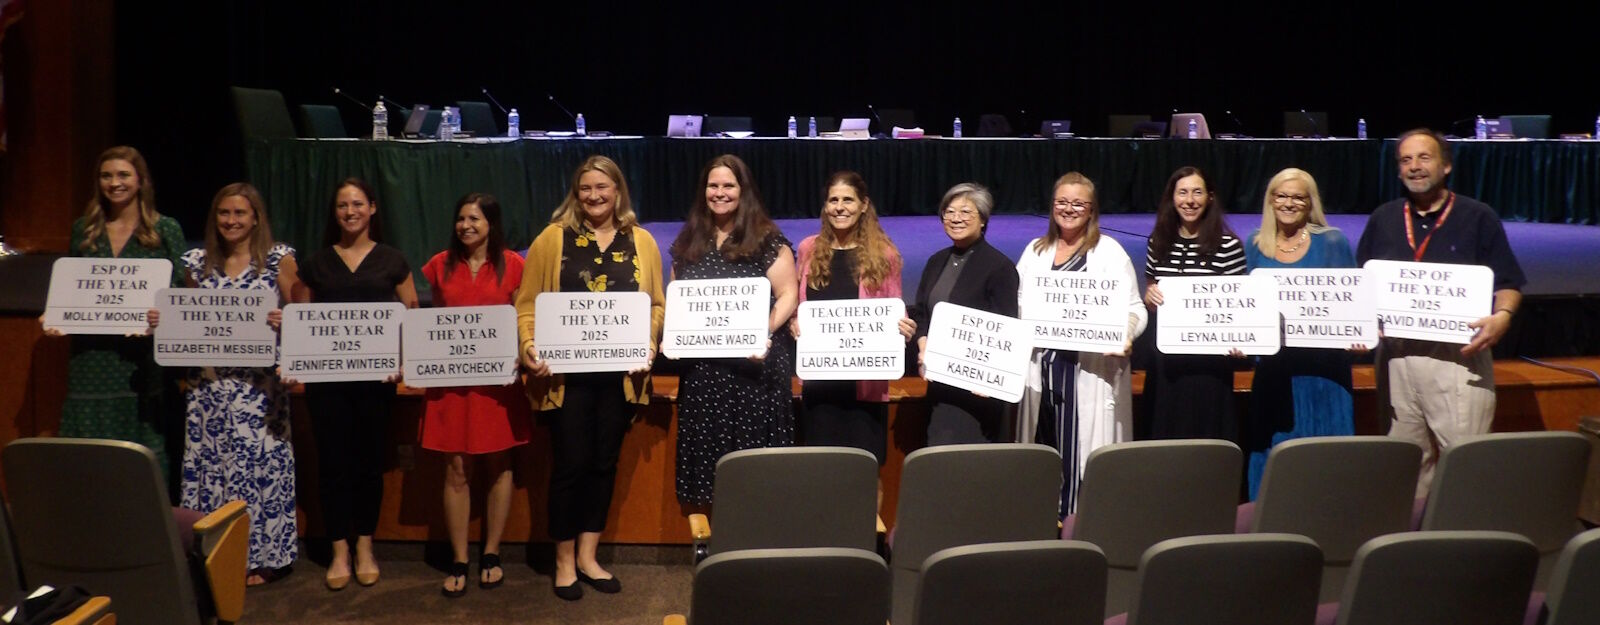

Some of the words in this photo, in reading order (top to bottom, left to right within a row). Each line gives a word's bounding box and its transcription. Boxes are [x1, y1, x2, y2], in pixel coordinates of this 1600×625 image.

[90, 265, 117, 274] ESP
[121, 265, 140, 275] OF
[1400, 269, 1427, 279] ESP
[1431, 271, 1452, 281] OF
[76, 280, 105, 290] THE
[110, 280, 148, 290] YEAR
[1035, 277, 1097, 289] TEACHER
[1101, 280, 1120, 290] OF
[1340, 276, 1362, 285] OF
[679, 286, 738, 296] TEACHER
[741, 285, 759, 295] OF
[1192, 284, 1217, 293] ESP
[1221, 283, 1241, 293] OF
[1388, 283, 1420, 293] THE
[1424, 285, 1467, 297] YEAR
[95, 295, 124, 304] 2025
[168, 295, 240, 306] TEACHER
[244, 296, 264, 306] OF
[1045, 293, 1070, 303] THE
[1074, 294, 1109, 306] YEAR
[1279, 291, 1306, 300] THE
[1311, 291, 1353, 301] YEAR
[570, 300, 594, 310] ESP
[598, 300, 617, 310] OF
[687, 302, 712, 312] THE
[716, 301, 750, 311] YEAR
[1183, 299, 1212, 308] THE
[1216, 298, 1256, 308] YEAR
[1410, 299, 1441, 310] 2025
[63, 312, 102, 321] MOLLY
[104, 312, 147, 321] MOONE
[181, 311, 211, 321] THE
[215, 311, 255, 321] YEAR
[296, 310, 369, 320] TEACHER
[373, 309, 394, 320] OF
[810, 307, 871, 318] TEACHER
[875, 306, 892, 316] OF
[1062, 309, 1088, 320] 2025
[1300, 307, 1329, 316] 2025
[436, 314, 460, 325] ESP
[464, 313, 483, 324] OF
[560, 315, 588, 326] THE
[593, 315, 630, 325] YEAR
[705, 317, 729, 326] 2025
[962, 315, 983, 328] ESP
[986, 320, 1004, 333] OF
[1205, 314, 1233, 323] 2025
[309, 326, 339, 336] THE
[344, 325, 384, 336] YEAR
[820, 323, 845, 333] THE
[849, 322, 884, 332] YEAR
[1418, 318, 1475, 332] MADDE
[203, 327, 233, 336] 2025
[427, 330, 456, 340] THE
[459, 328, 497, 339] YEAR
[581, 331, 608, 341] 2025
[1051, 328, 1122, 341] MASTROIANNI
[1308, 326, 1362, 336] MULLEN
[676, 335, 723, 346] SUZANNE
[726, 335, 756, 345] WARD
[839, 338, 864, 348] 2025
[951, 328, 976, 343] THE
[979, 334, 1012, 352] YEAR
[1181, 333, 1217, 342] LEYNA
[1221, 333, 1256, 342] LILLIA
[158, 344, 219, 353] ELIZABETH
[224, 345, 272, 354] MESSIER
[332, 341, 361, 351] 2025
[449, 345, 476, 355] 2025
[539, 349, 571, 360] MARIE
[574, 348, 646, 359] WURTEMBURG
[966, 348, 990, 362] 2025
[289, 360, 343, 371] JENNIFER
[347, 358, 395, 369] WINTERS
[802, 357, 839, 367] LAURA
[842, 357, 896, 367] LAMBERT
[417, 364, 446, 375] CARA
[449, 362, 504, 374] RYCHECKY
[947, 362, 985, 381] KAREN
[987, 373, 1005, 386] LAI
